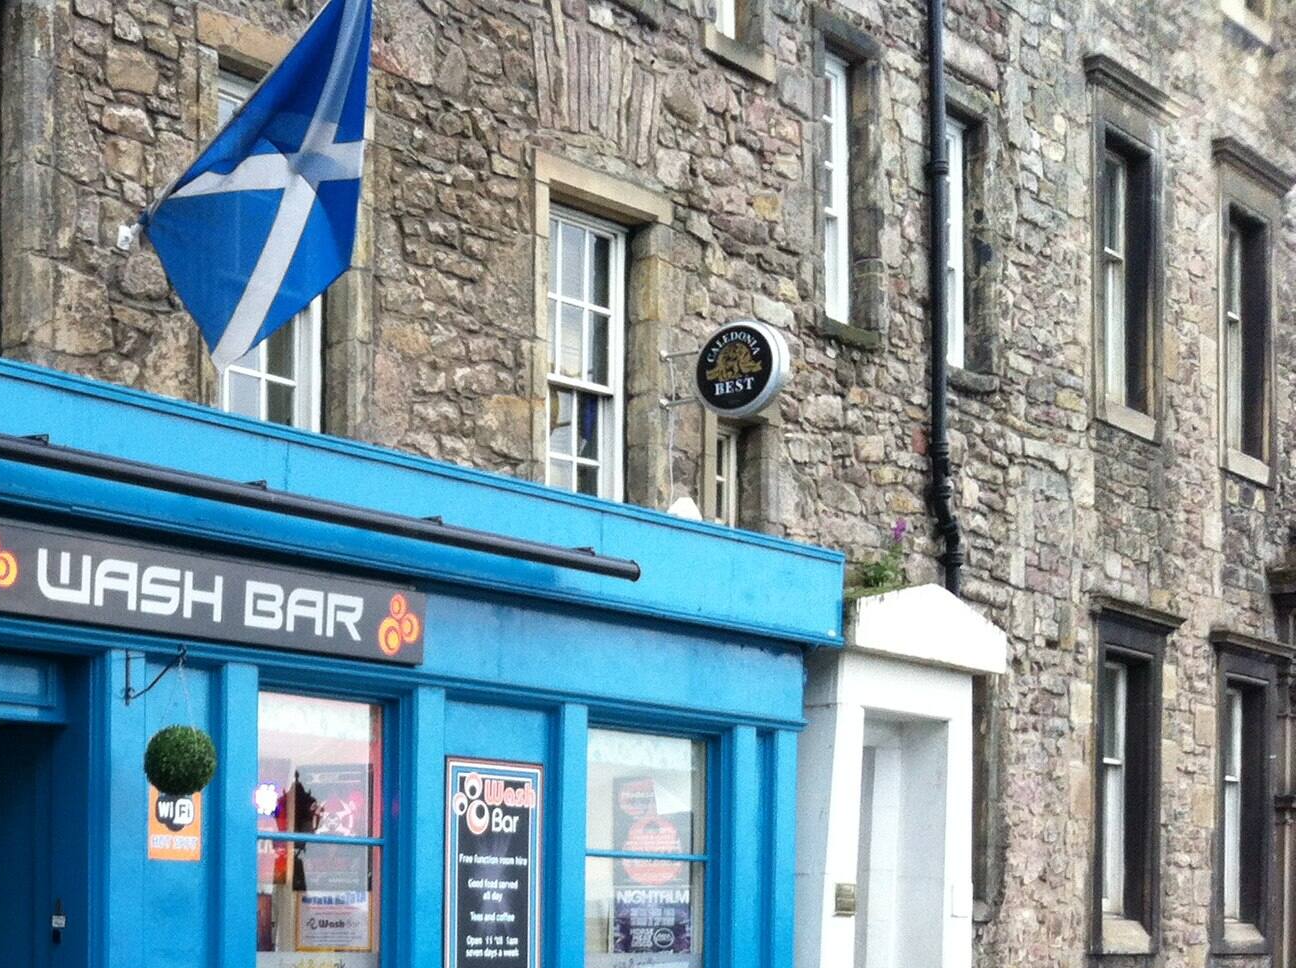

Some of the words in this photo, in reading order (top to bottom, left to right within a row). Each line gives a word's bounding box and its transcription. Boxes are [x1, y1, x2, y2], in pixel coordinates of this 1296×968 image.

[706, 331, 761, 363] CALEDONIA
[714, 376, 755, 395] BEST
[37, 548, 223, 622] WASH
[244, 580, 364, 641] BAR
[484, 779, 536, 809] Wash
[491, 807, 519, 833] Bar
[466, 935, 482, 946] Open
